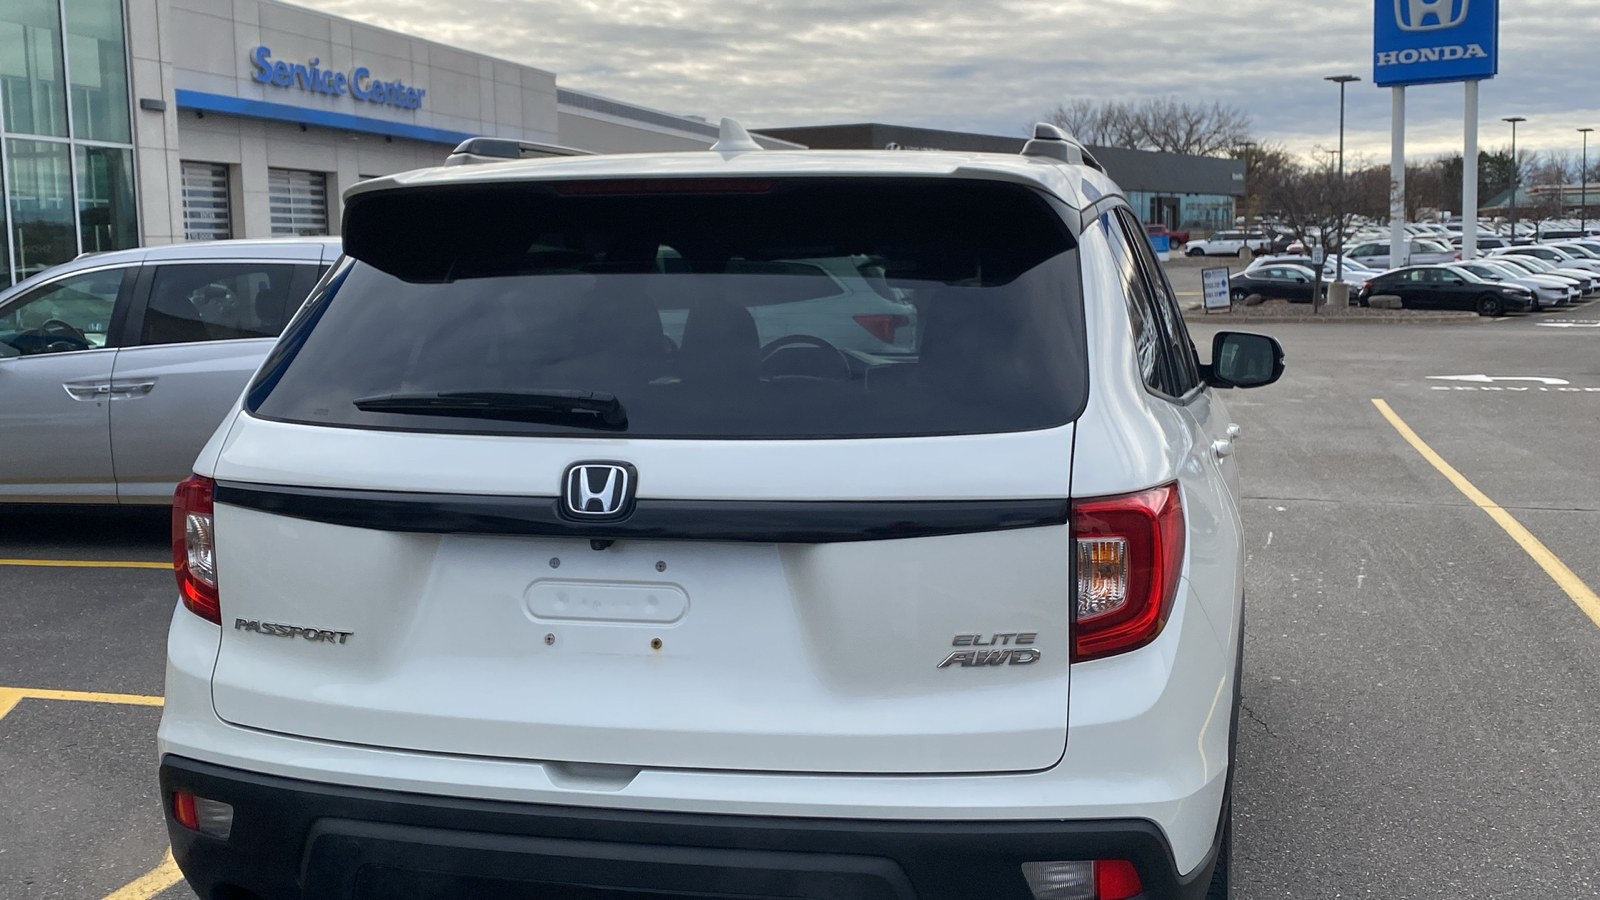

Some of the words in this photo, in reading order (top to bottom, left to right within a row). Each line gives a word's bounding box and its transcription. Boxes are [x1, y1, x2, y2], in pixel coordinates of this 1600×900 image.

[1376, 43, 1488, 66] HONDA
[251, 46, 347, 95] Service
[350, 67, 426, 109] Center
[234, 618, 354, 644] PASSPORT
[952, 632, 1037, 646] ELITE
[937, 648, 1041, 668] AWD
